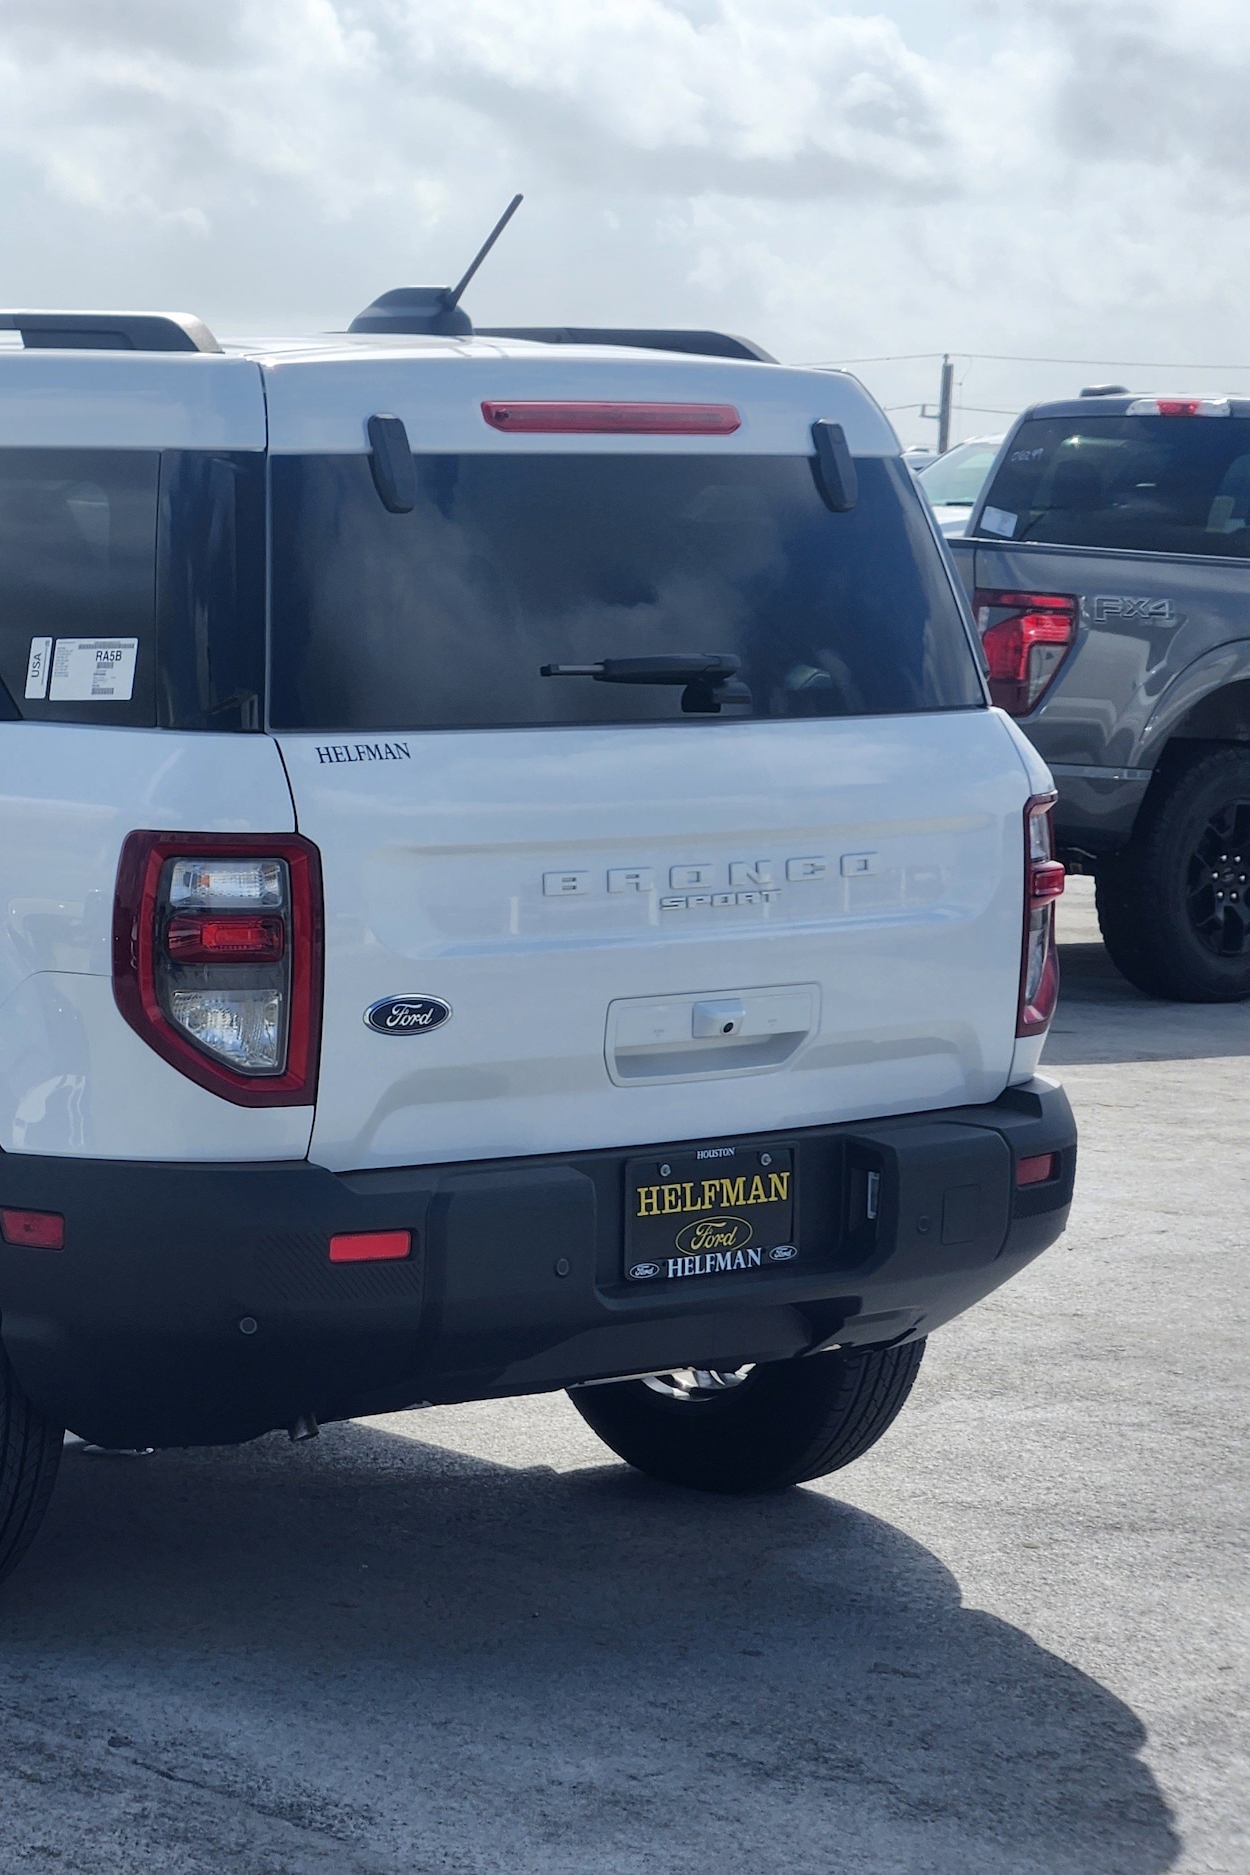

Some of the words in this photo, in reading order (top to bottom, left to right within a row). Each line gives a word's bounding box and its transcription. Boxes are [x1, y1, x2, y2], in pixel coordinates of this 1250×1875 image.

[1094, 596, 1171, 622] FX4
[31, 653, 42, 678] USA
[95, 650, 123, 662] RA5B
[315, 742, 412, 764] HELFMAN
[542, 851, 880, 897] BRONCO
[660, 888, 783, 911] SPORT
[386, 1003, 434, 1027] Ford
[696, 1147, 736, 1160] HOUSTON
[636, 1171, 791, 1217] HELFMAN
[690, 1221, 739, 1251] Ford
[667, 1247, 763, 1278] HELFMAN
